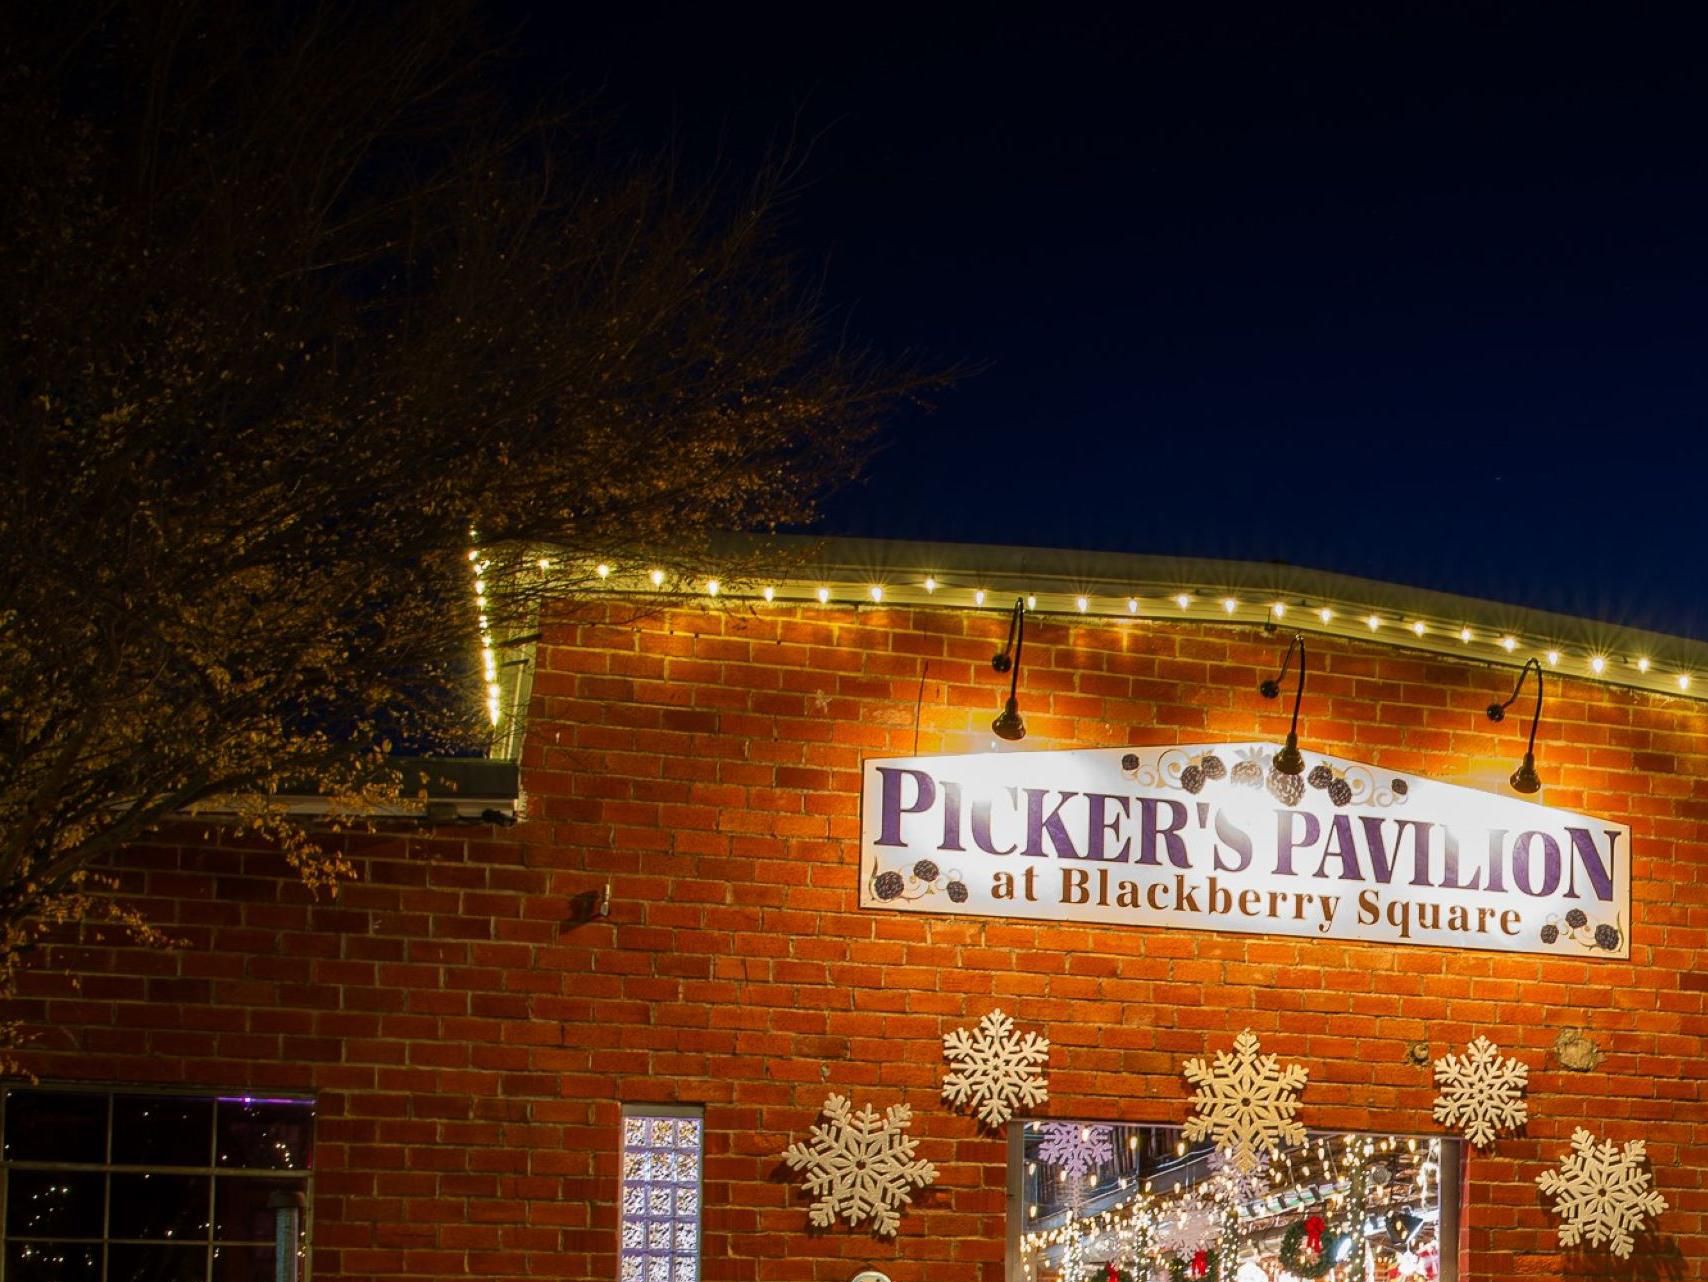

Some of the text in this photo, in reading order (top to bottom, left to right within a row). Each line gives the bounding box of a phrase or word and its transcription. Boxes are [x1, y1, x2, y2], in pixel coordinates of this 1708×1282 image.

[874, 766, 1622, 902] PICKER'S PAVILION
[991, 865, 1522, 938] at Blackberry Square
